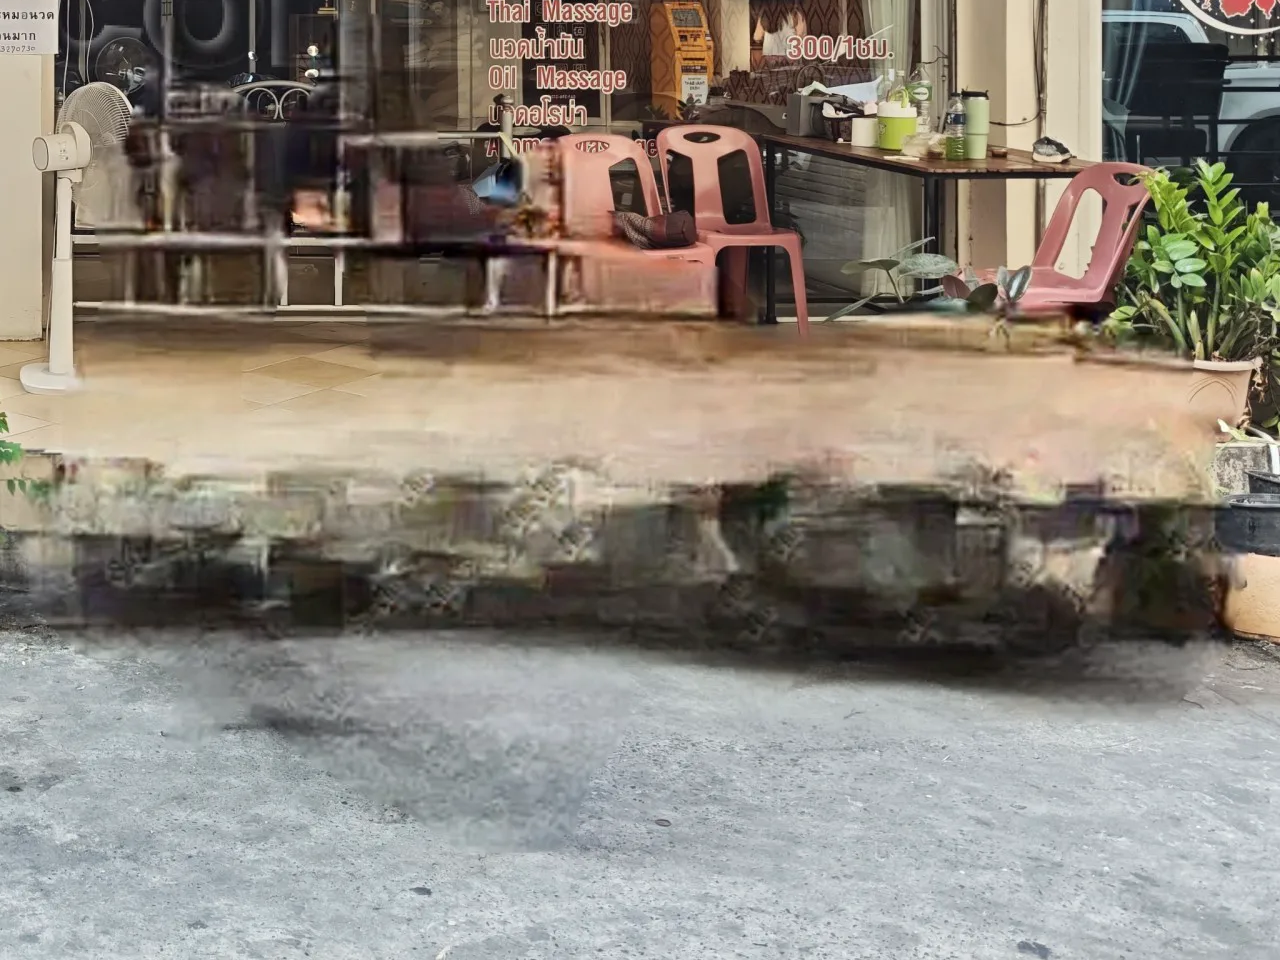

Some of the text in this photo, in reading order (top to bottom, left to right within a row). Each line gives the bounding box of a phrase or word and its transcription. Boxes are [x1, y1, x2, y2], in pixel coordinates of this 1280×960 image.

[486, 0, 633, 28] Thai Massage
[489, 26, 895, 62] นวดน้ำมัน 300/1ชม.
[489, 66, 627, 95] Oil Massage
